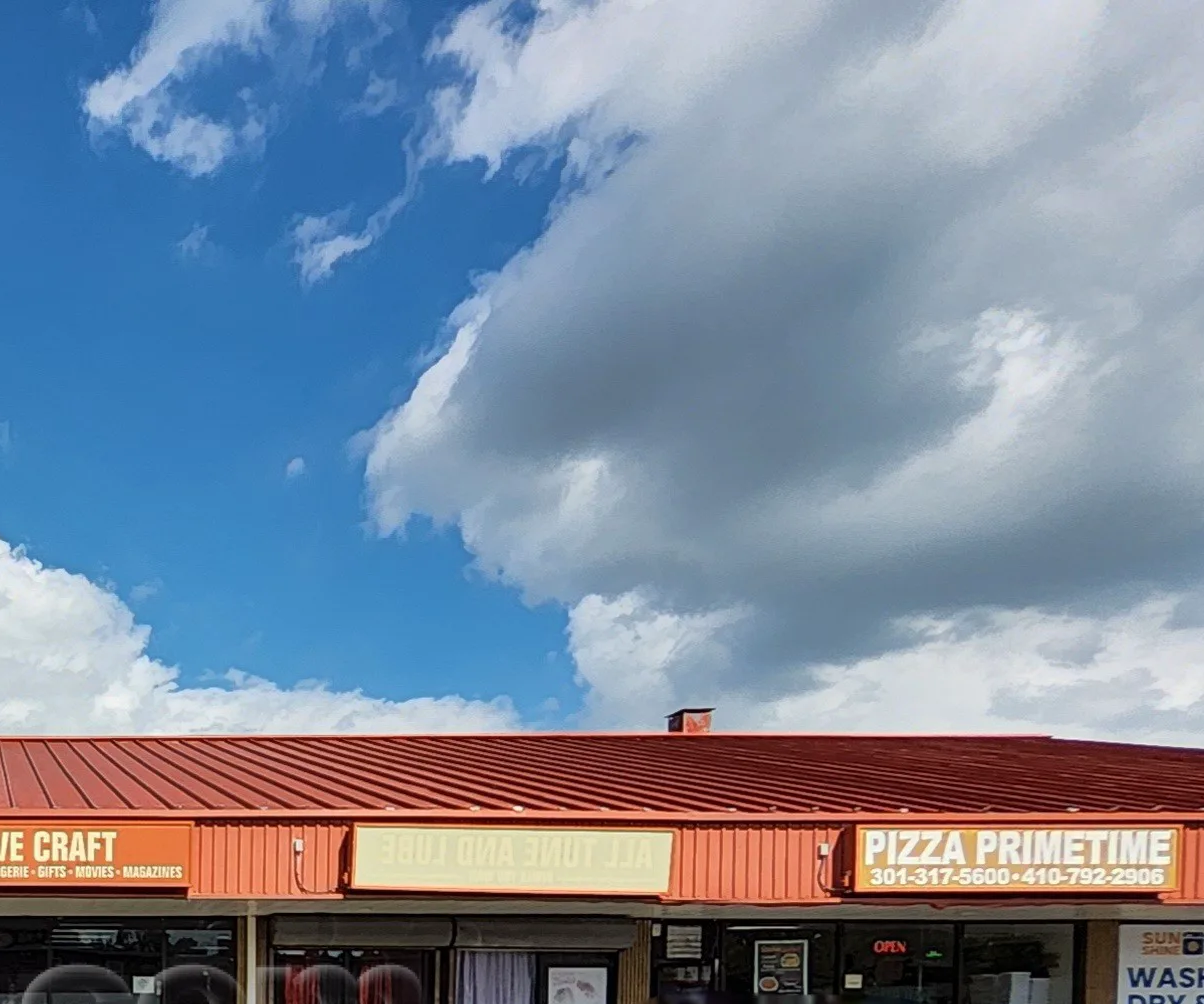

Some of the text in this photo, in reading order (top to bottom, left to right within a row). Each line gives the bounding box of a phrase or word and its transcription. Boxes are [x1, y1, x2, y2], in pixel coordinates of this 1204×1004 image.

[33, 831, 117, 862] CRAFT
[865, 830, 1172, 865] PIZZA PRIMETIME
[38, 866, 67, 879] GIFTS
[75, 866, 114, 879] MOVIES
[123, 866, 183, 879] MAGAZINES
[1142, 932, 1181, 945] SUN
[874, 940, 907, 953] OPEN
